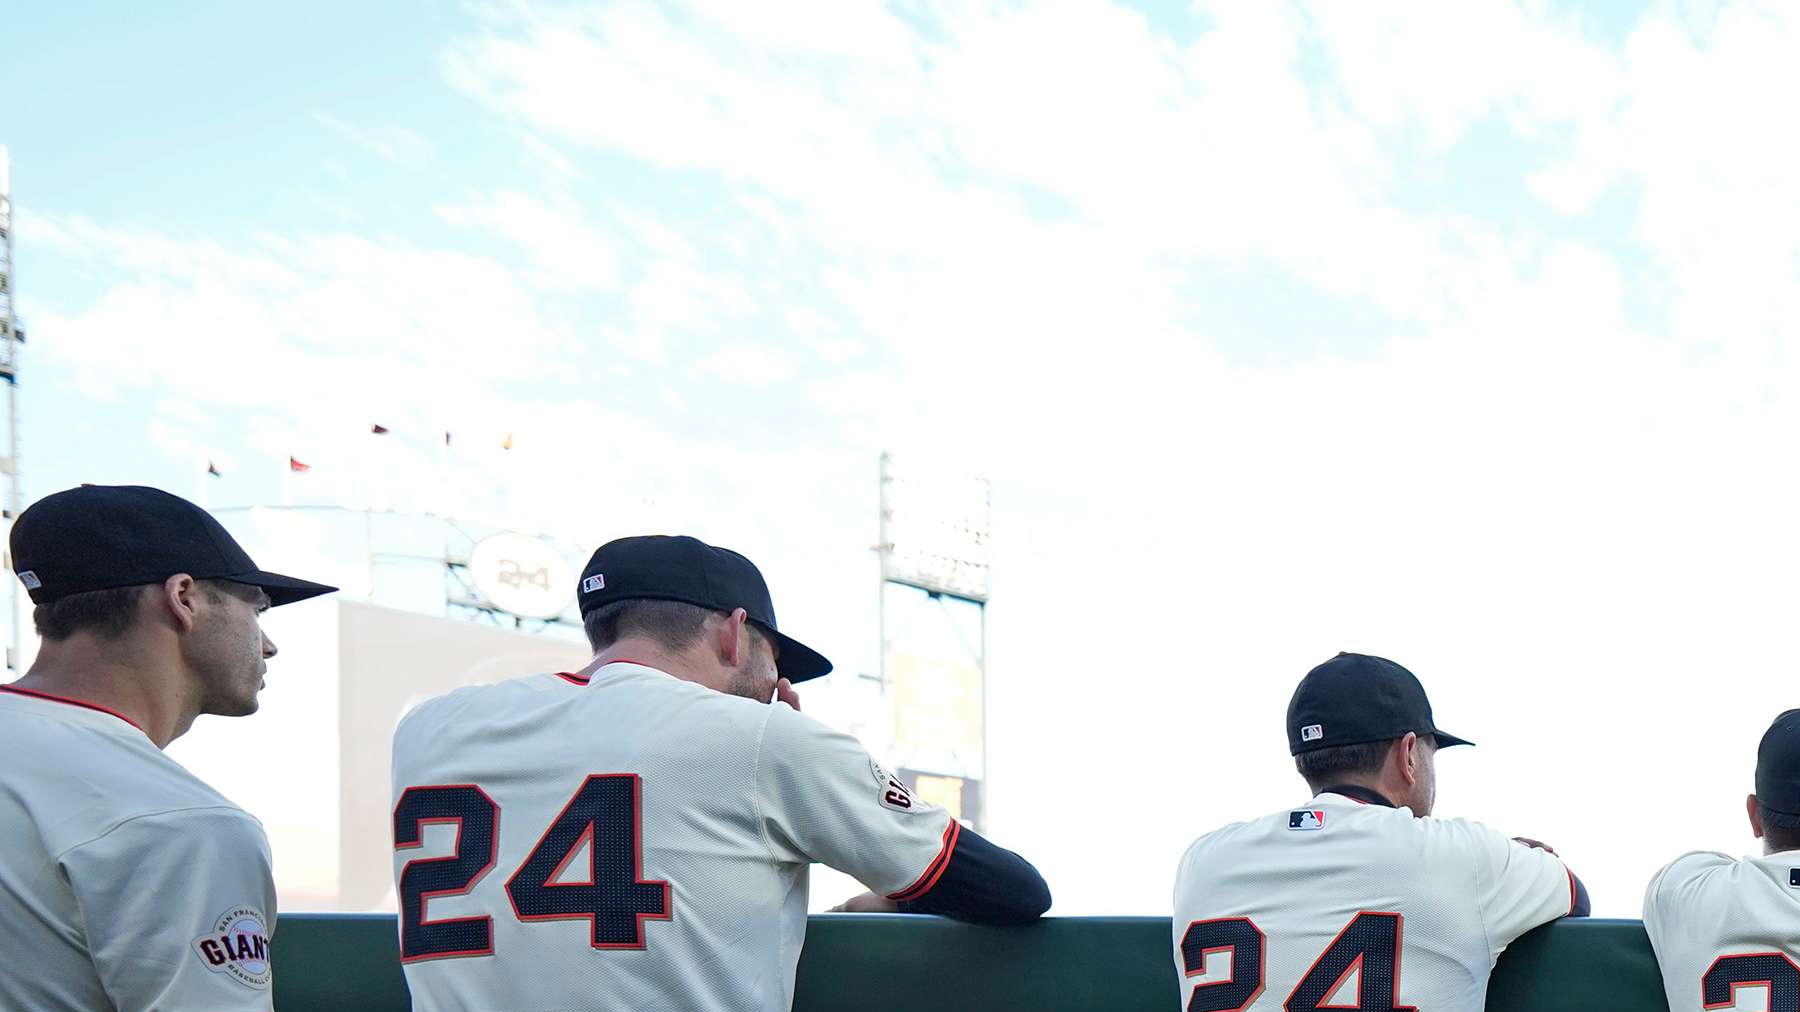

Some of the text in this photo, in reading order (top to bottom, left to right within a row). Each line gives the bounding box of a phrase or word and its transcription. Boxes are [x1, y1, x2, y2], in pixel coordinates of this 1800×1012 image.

[496, 559, 552, 592] 24
[394, 773, 672, 964] 24
[219, 915, 233, 932] SAN
